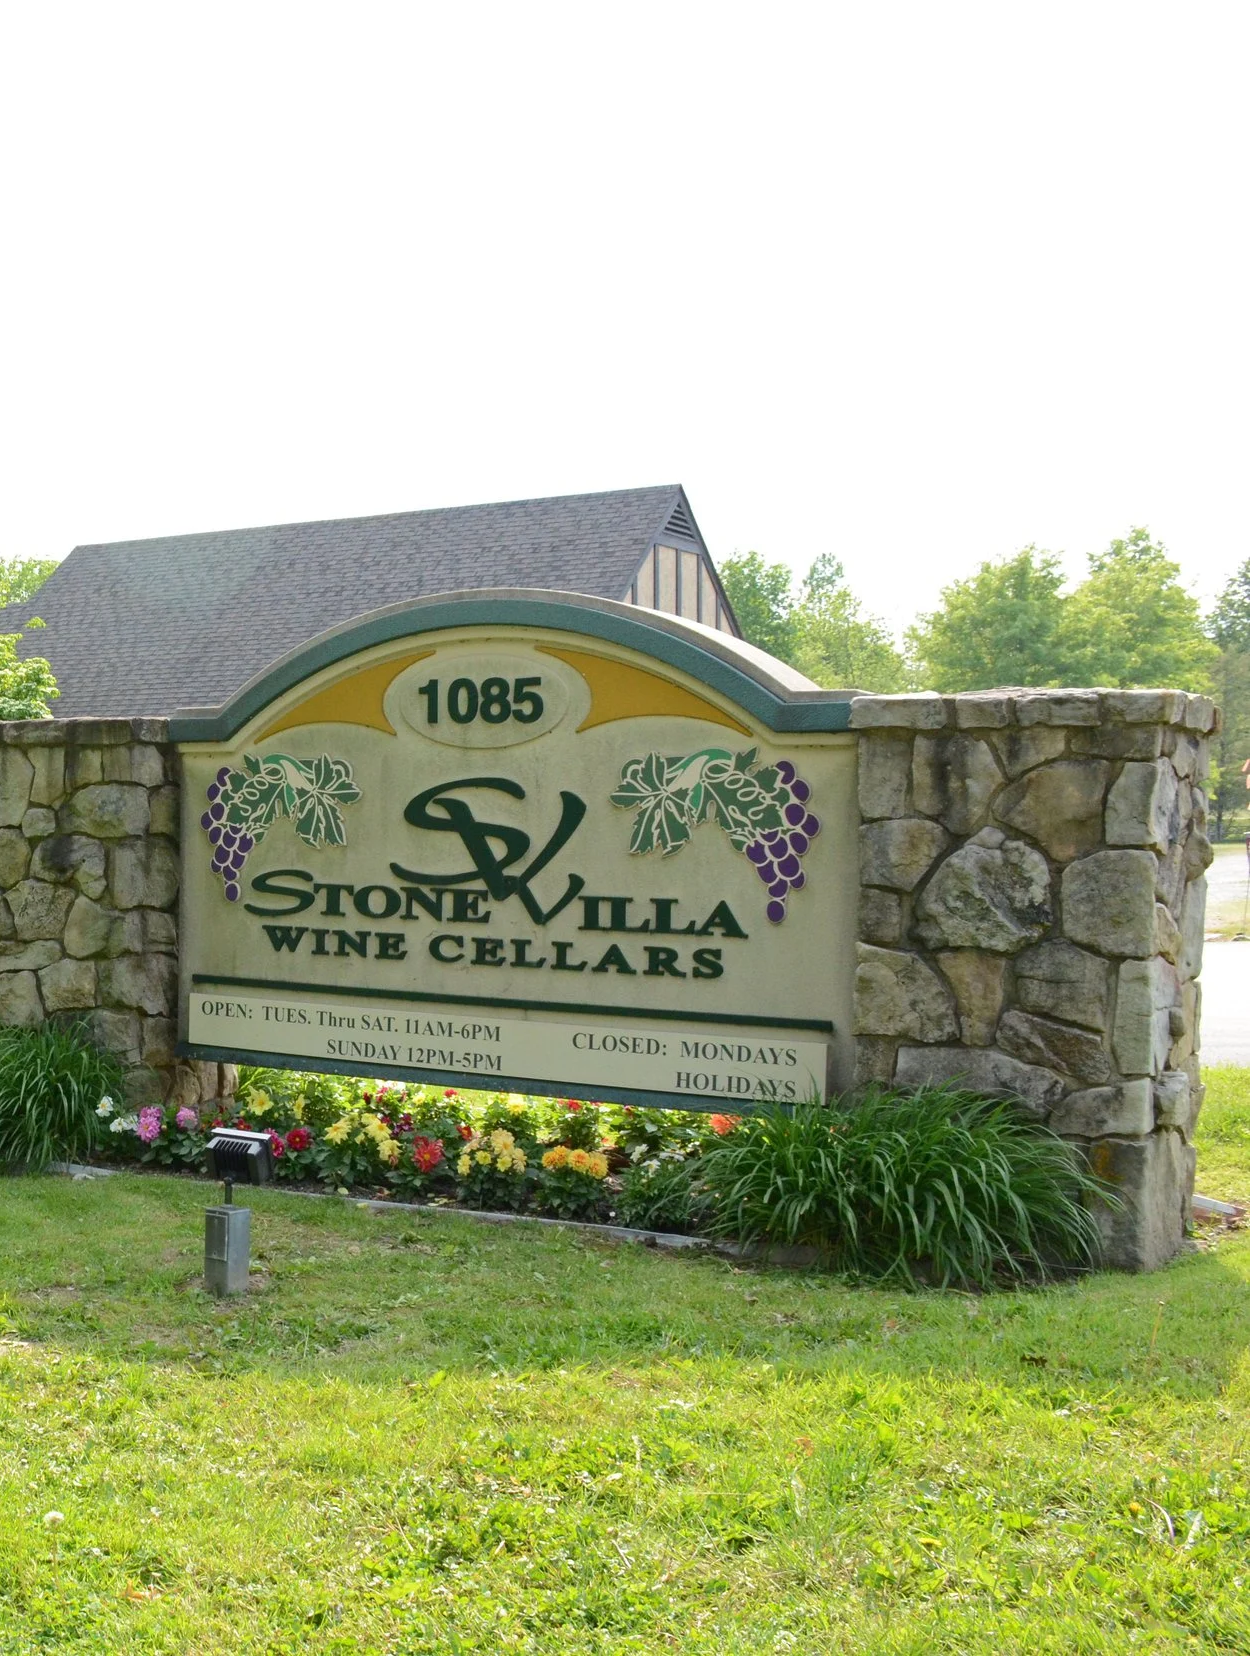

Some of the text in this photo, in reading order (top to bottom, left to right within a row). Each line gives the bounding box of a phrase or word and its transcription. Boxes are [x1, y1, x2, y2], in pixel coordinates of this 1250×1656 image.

[418, 676, 544, 724] 1085
[243, 868, 749, 939] STONE VILLA
[262, 924, 725, 979] WINE CELLARS
[201, 1000, 502, 1043] OPEN: TUES. Thru SAT. 11AM-6PM
[326, 1038, 503, 1071] SUNDAY 12PM-5PM
[572, 1032, 797, 1067] CLOSED: MONDAYS
[675, 1071, 797, 1099] HOLIDAYS
